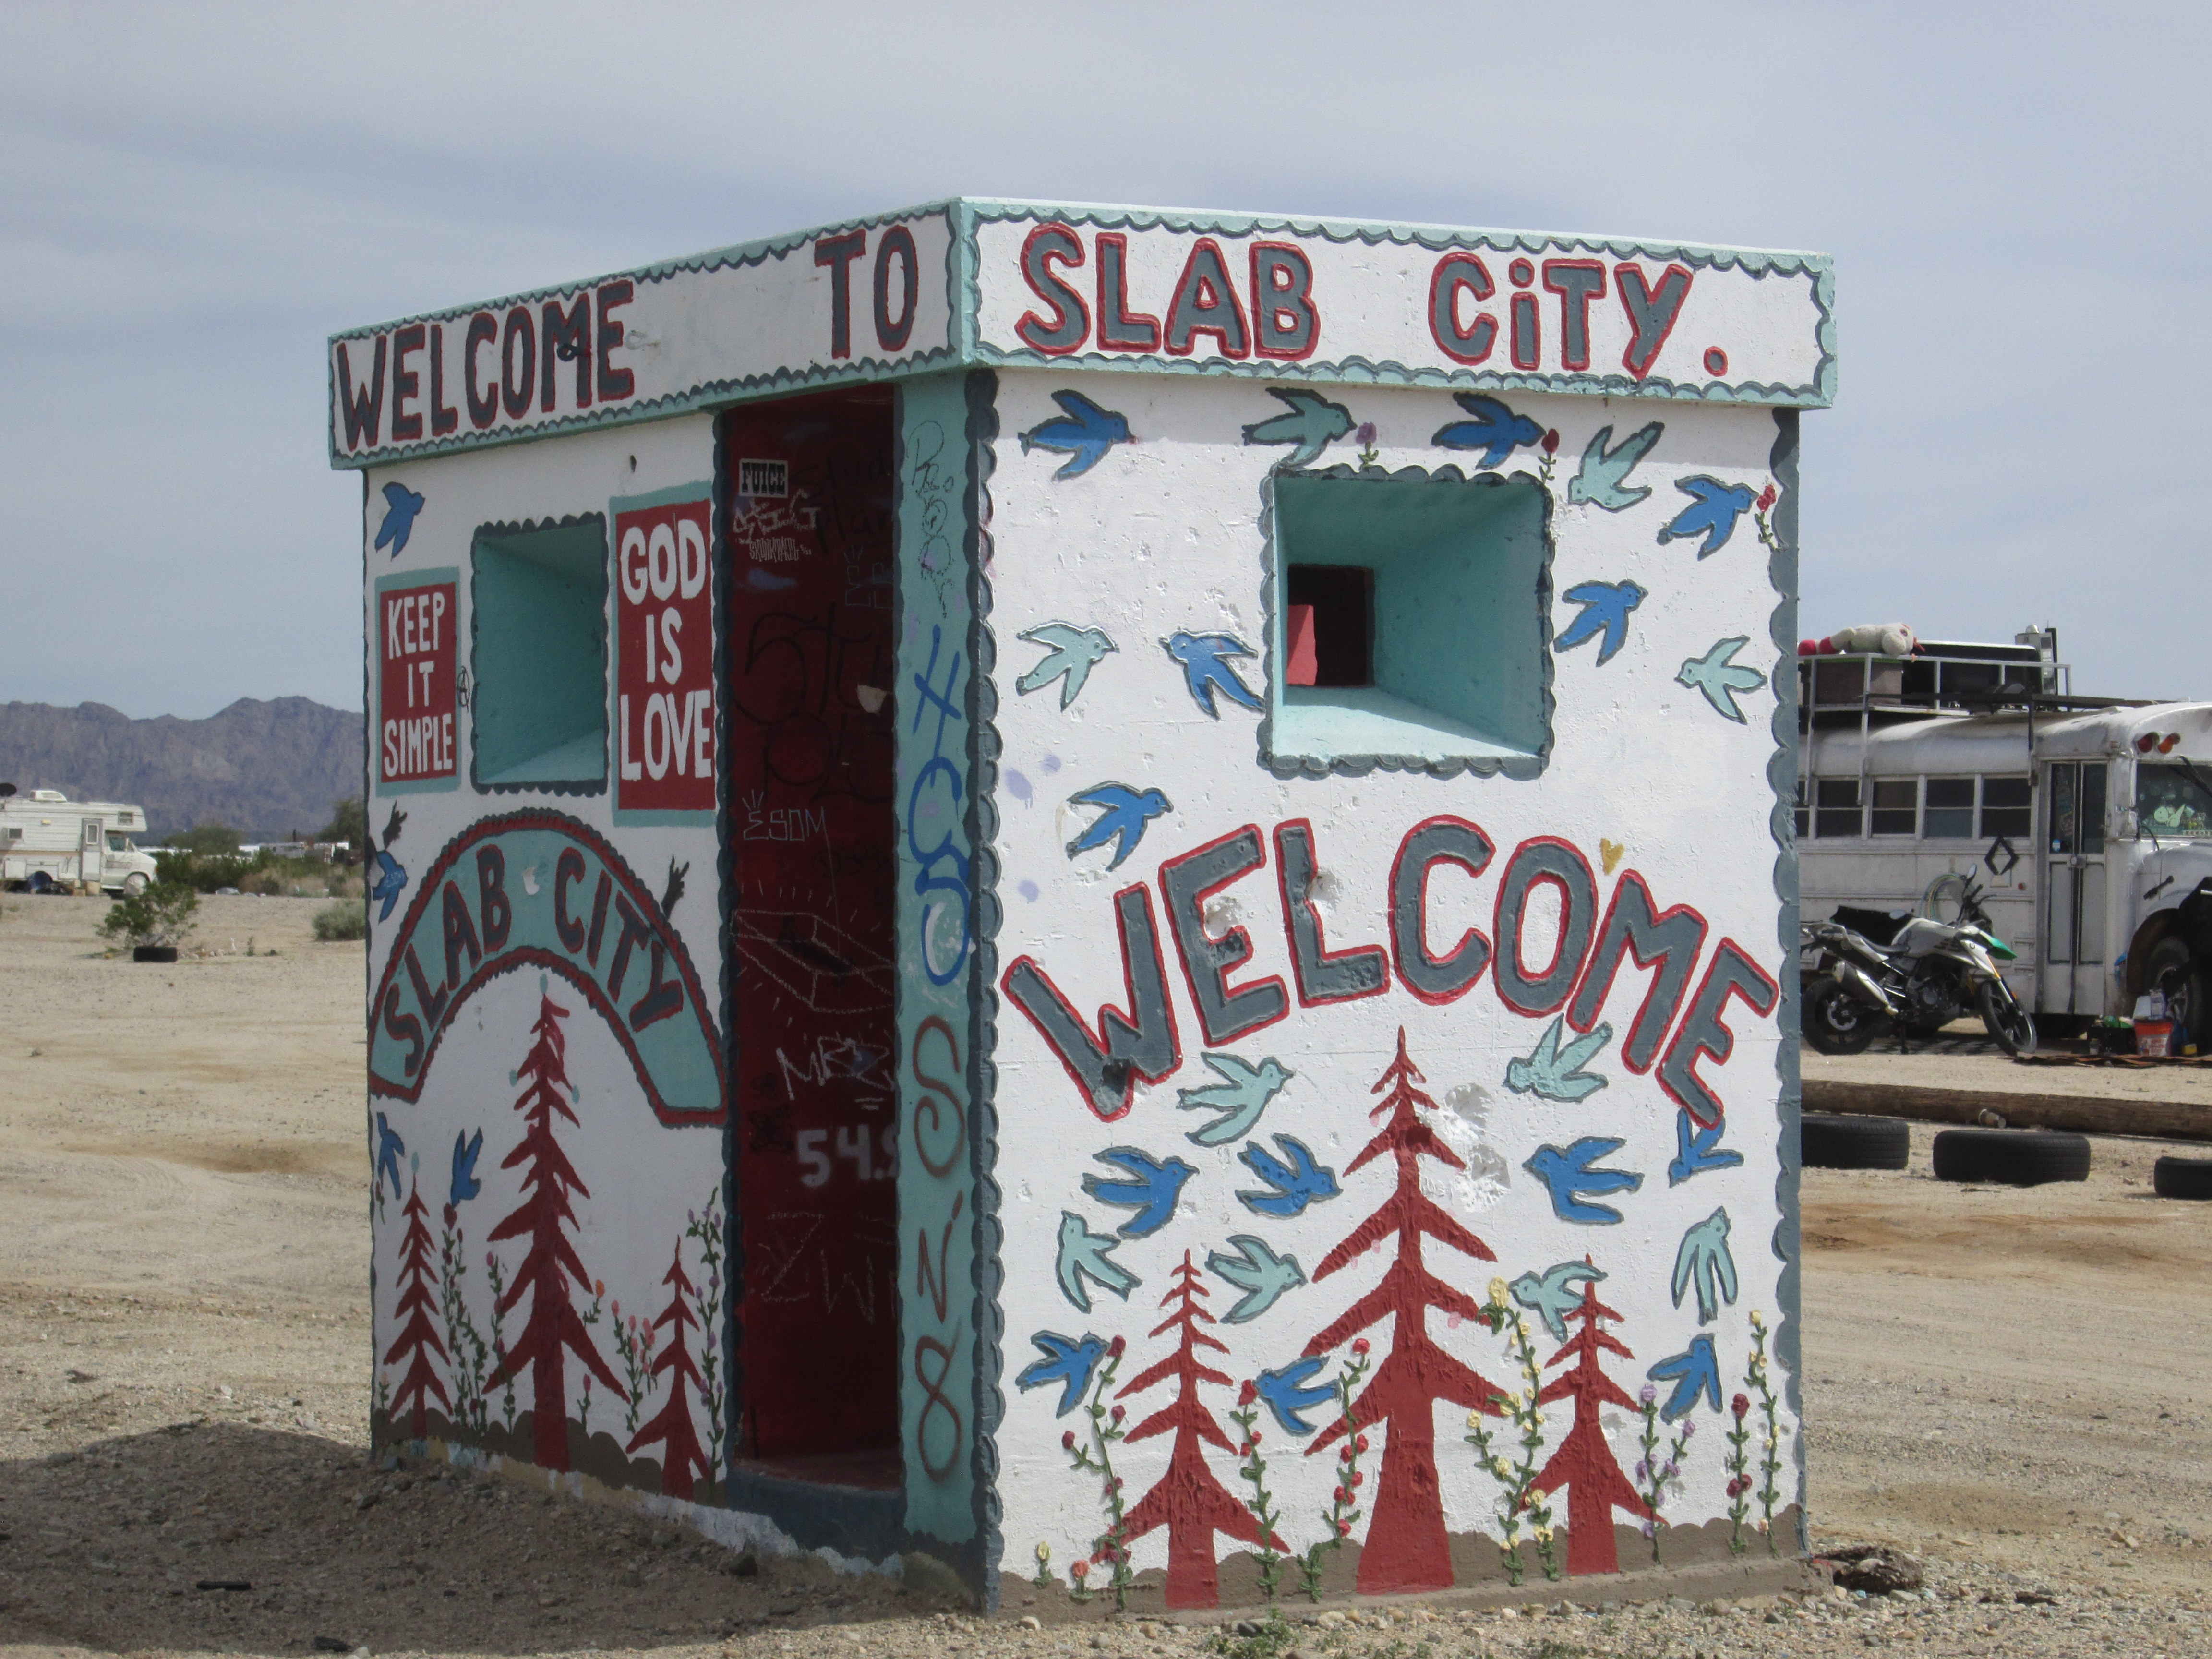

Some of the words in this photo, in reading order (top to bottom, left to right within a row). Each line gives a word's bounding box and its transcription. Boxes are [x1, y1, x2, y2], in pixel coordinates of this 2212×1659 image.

[1015, 222, 1320, 360] SLAB
[337, 279, 635, 451] WELCOME
[815, 225, 918, 359] TO
[620, 519, 706, 605] GOD
[387, 591, 445, 660] KEEP
[646, 607, 683, 685] IS
[408, 661, 434, 708] IT
[384, 714, 452, 777] SIMPLE
[620, 689, 712, 781] LOVE
[384, 844, 511, 1077] SLAB
[555, 846, 684, 1033] CITY
[1001, 815, 1778, 1129] WELCOME
